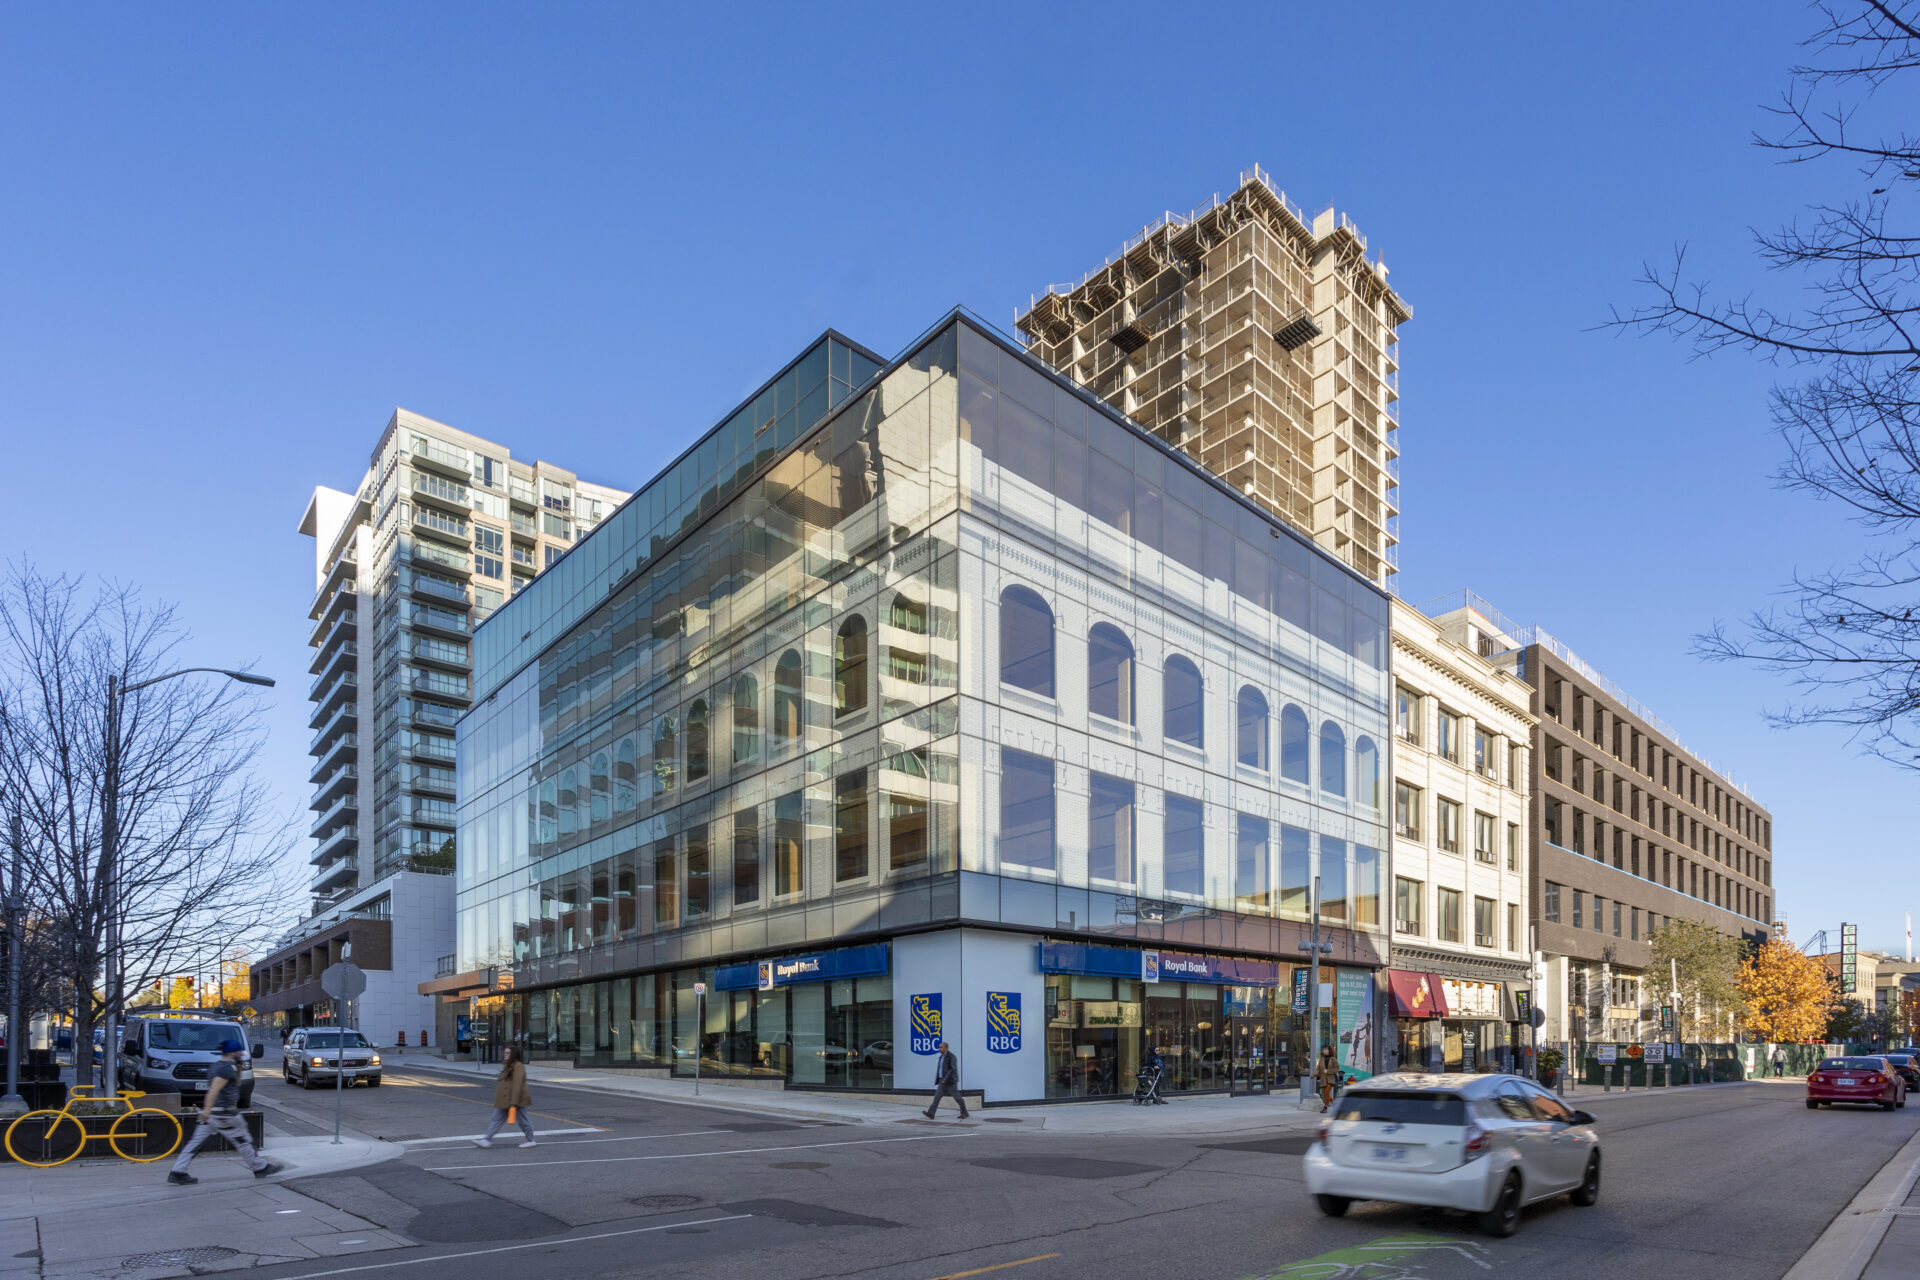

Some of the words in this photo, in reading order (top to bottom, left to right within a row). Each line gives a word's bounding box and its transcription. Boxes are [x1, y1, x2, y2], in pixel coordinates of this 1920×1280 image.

[1844, 926, 1855, 991] ELEMENT
[777, 962, 799, 978] Royal
[799, 959, 820, 972] Bank
[1165, 960, 1187, 974] Royal
[1188, 961, 1207, 973] Bank
[1300, 970, 1308, 1006] KITCHENER
[913, 1038, 941, 1052] RBC
[990, 1036, 1019, 1050] RBC
